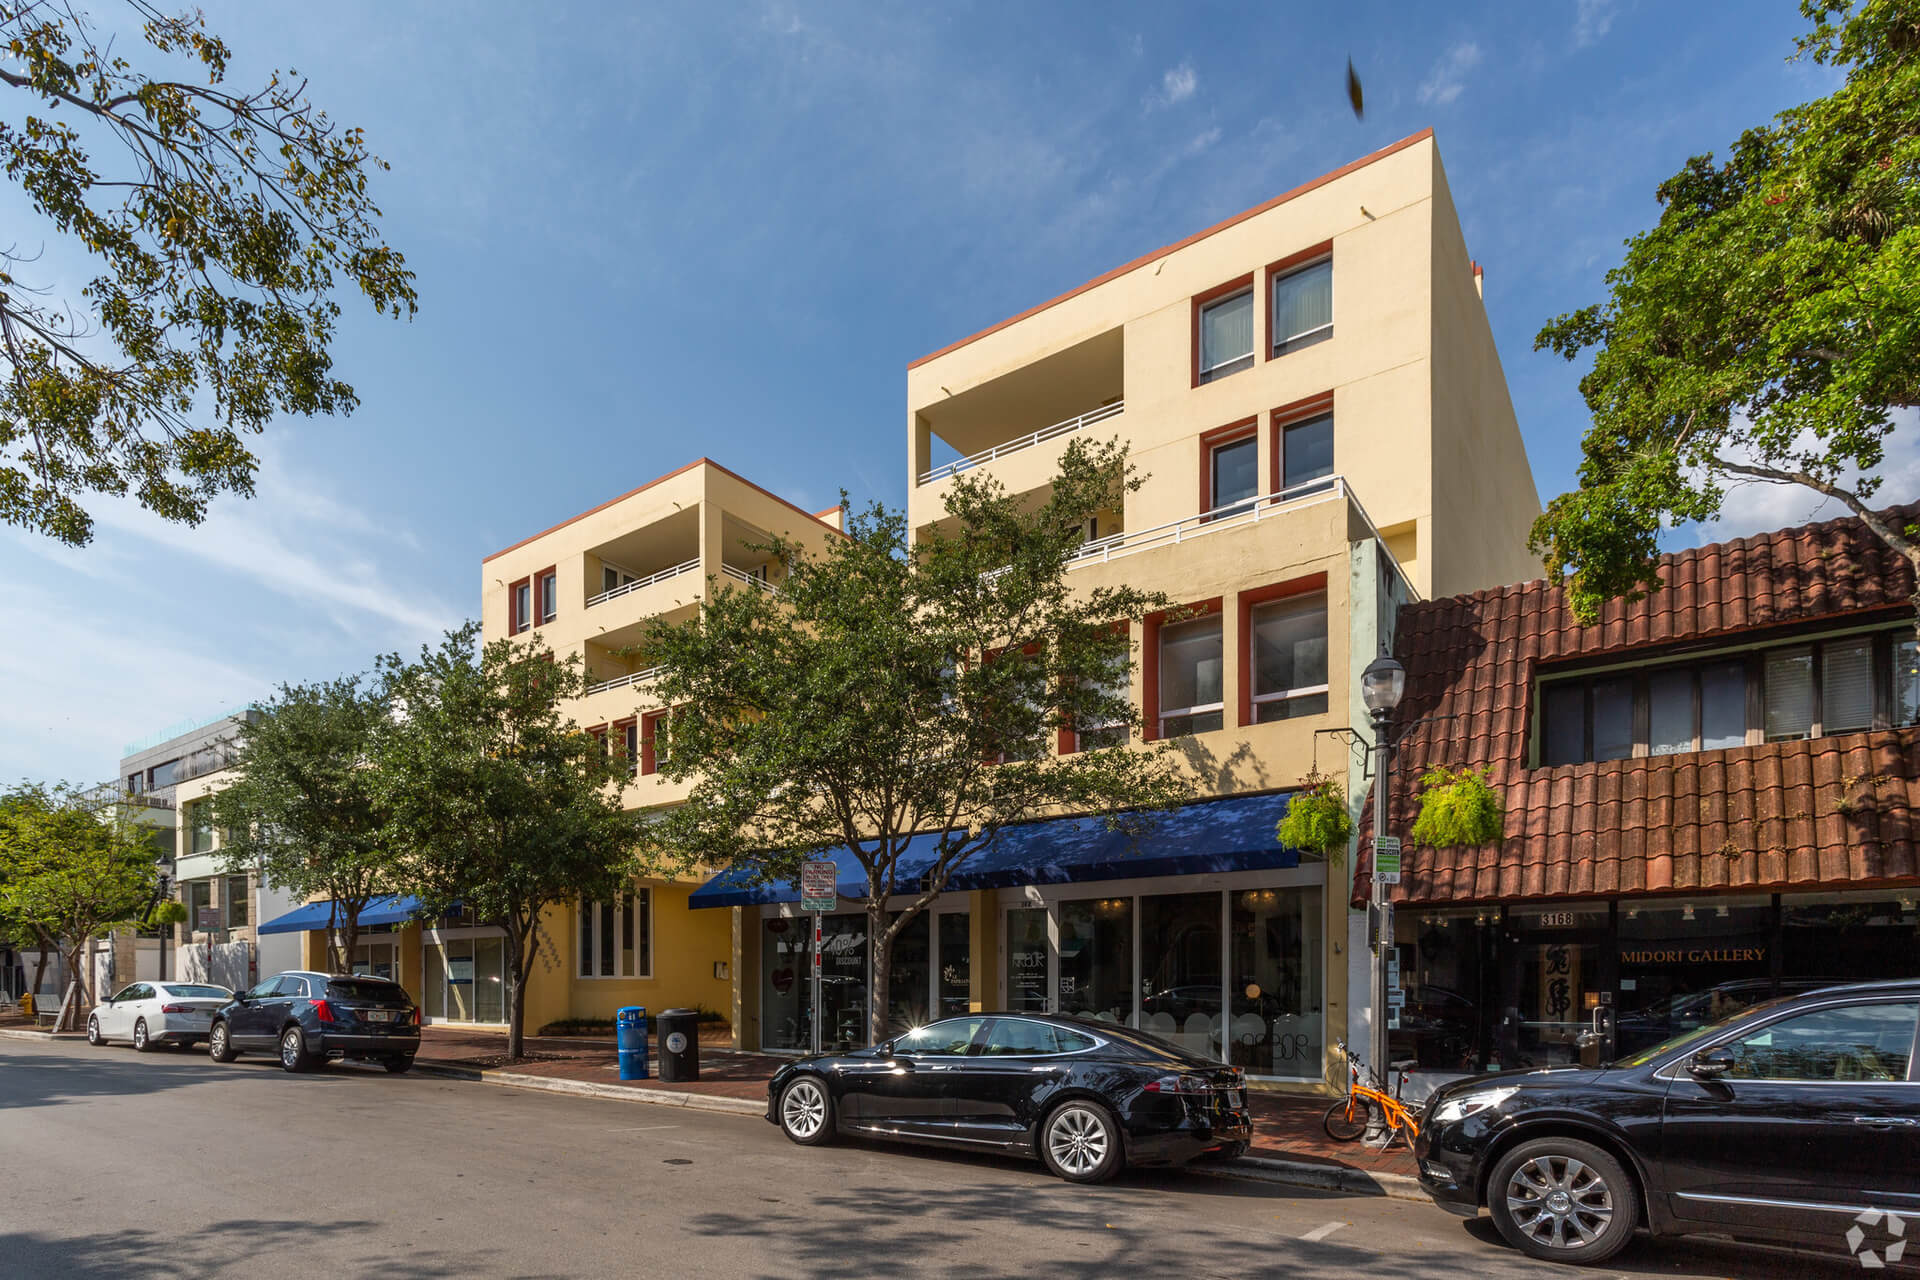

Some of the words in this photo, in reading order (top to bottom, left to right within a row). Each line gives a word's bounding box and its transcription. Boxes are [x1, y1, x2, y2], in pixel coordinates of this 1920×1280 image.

[1542, 912, 1572, 926] 3168
[1621, 950, 1683, 963] MIDORI
[1687, 948, 1766, 962] GALLERY
